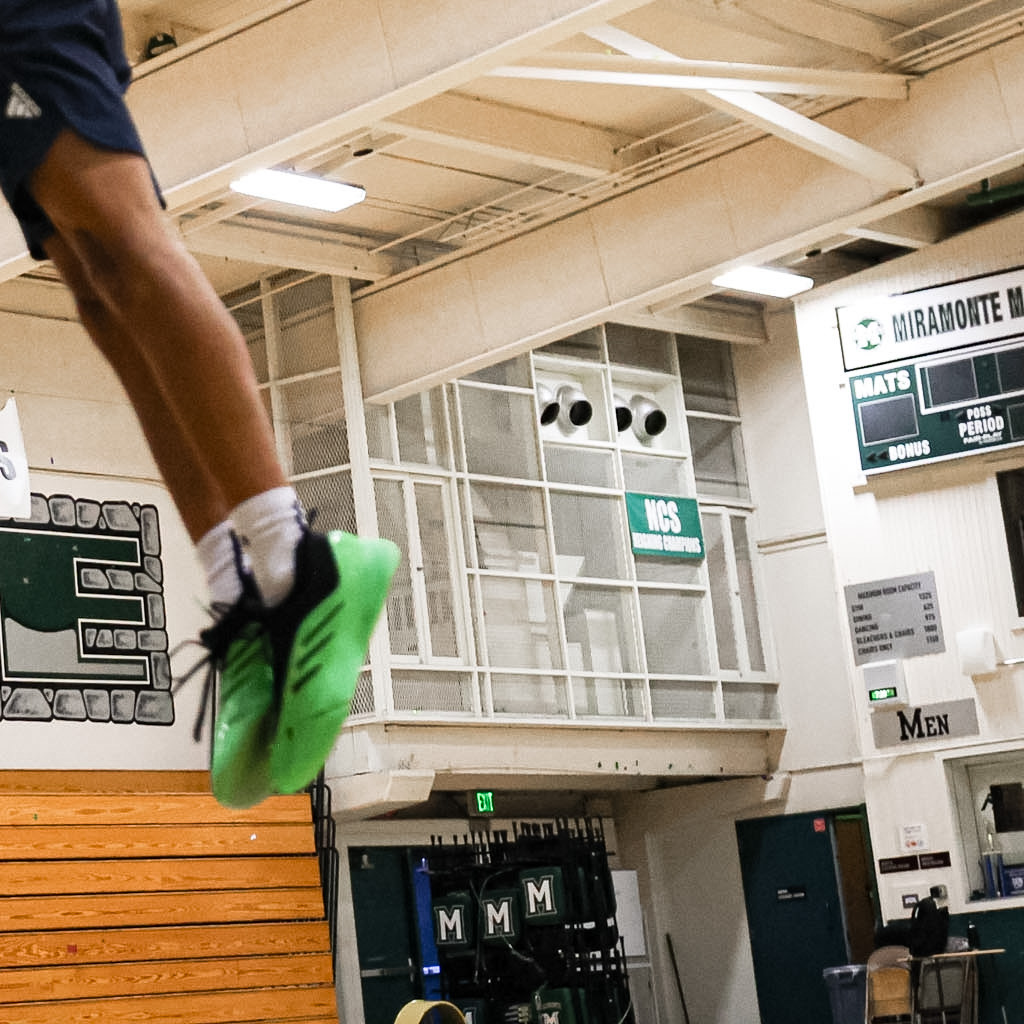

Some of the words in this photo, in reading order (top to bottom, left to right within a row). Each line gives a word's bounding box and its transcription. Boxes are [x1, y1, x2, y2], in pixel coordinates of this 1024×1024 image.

[892, 291, 1004, 343] MIRAMONTE
[853, 369, 911, 399] MATS
[958, 415, 1005, 438] PERIOD
[967, 405, 992, 420] POSS
[888, 439, 931, 462] BONUS
[644, 498, 682, 534] NCS
[524, 876, 556, 916] M
[436, 906, 466, 943] M
[484, 898, 513, 937] M
